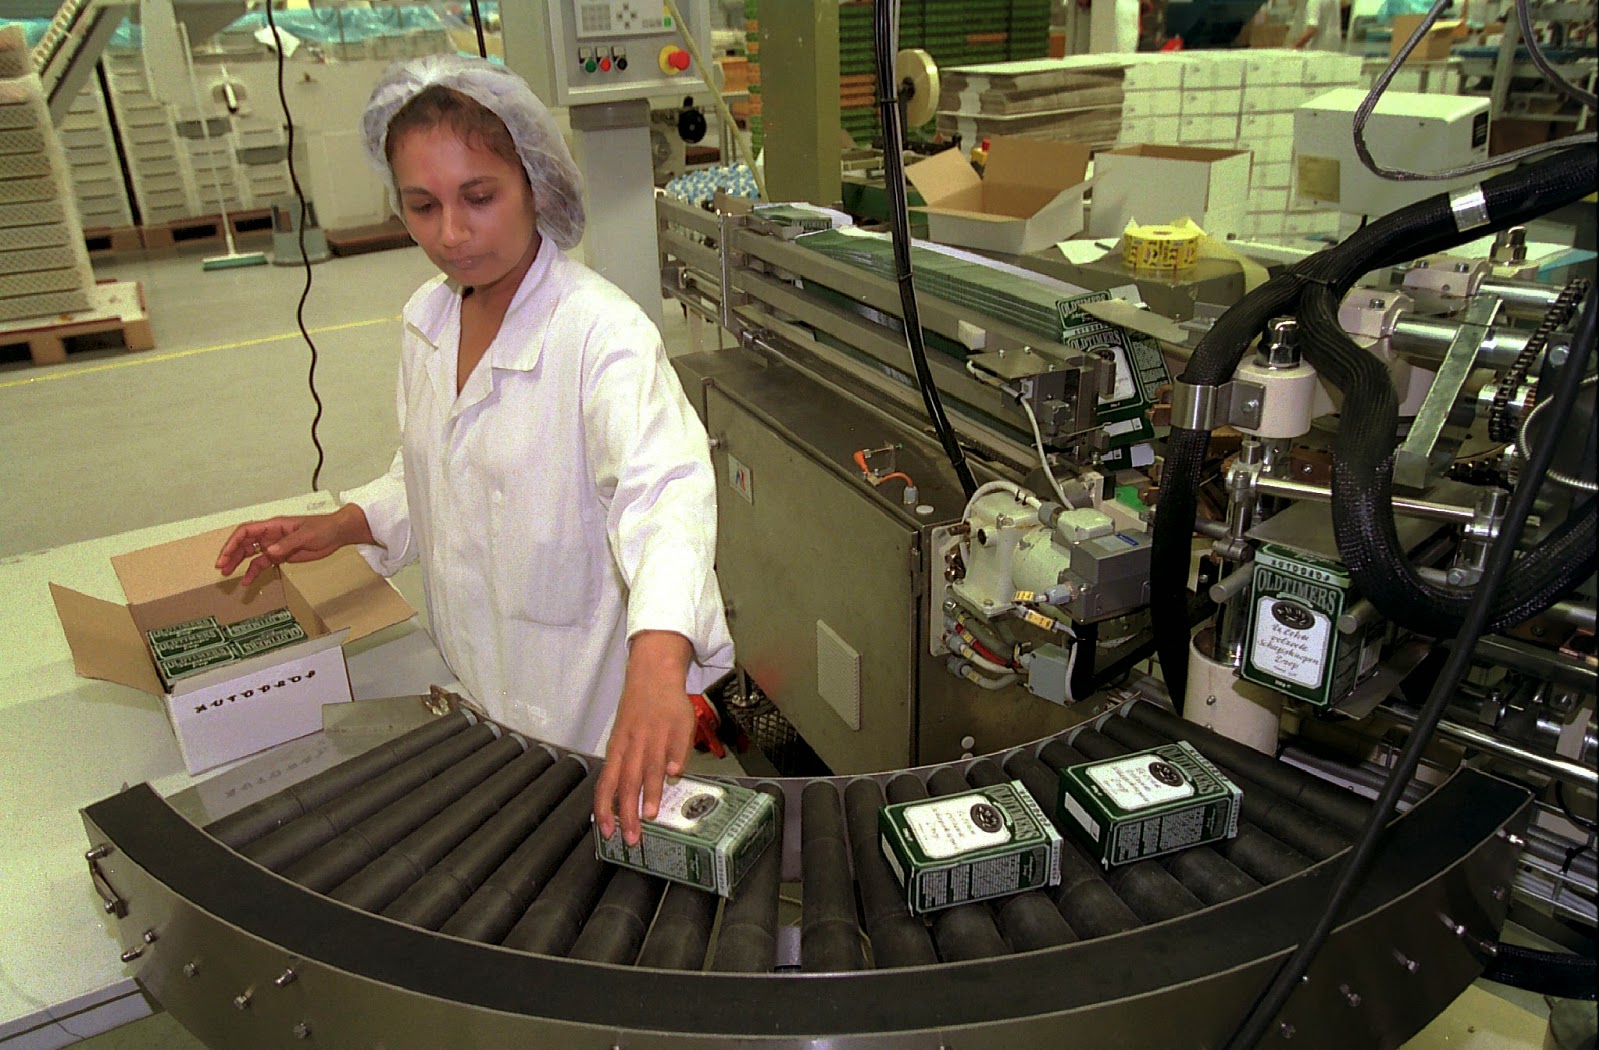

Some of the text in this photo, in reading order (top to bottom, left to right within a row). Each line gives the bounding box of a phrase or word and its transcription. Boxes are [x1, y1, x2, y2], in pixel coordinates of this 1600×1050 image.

[1069, 329, 1122, 351] OLDTIMERS
[1257, 569, 1338, 616] OLDTIMERS
[1271, 559, 1332, 582] AUTODROP
[194, 669, 317, 714] AUTODROP
[983, 785, 1041, 842] OLDTIMERS
